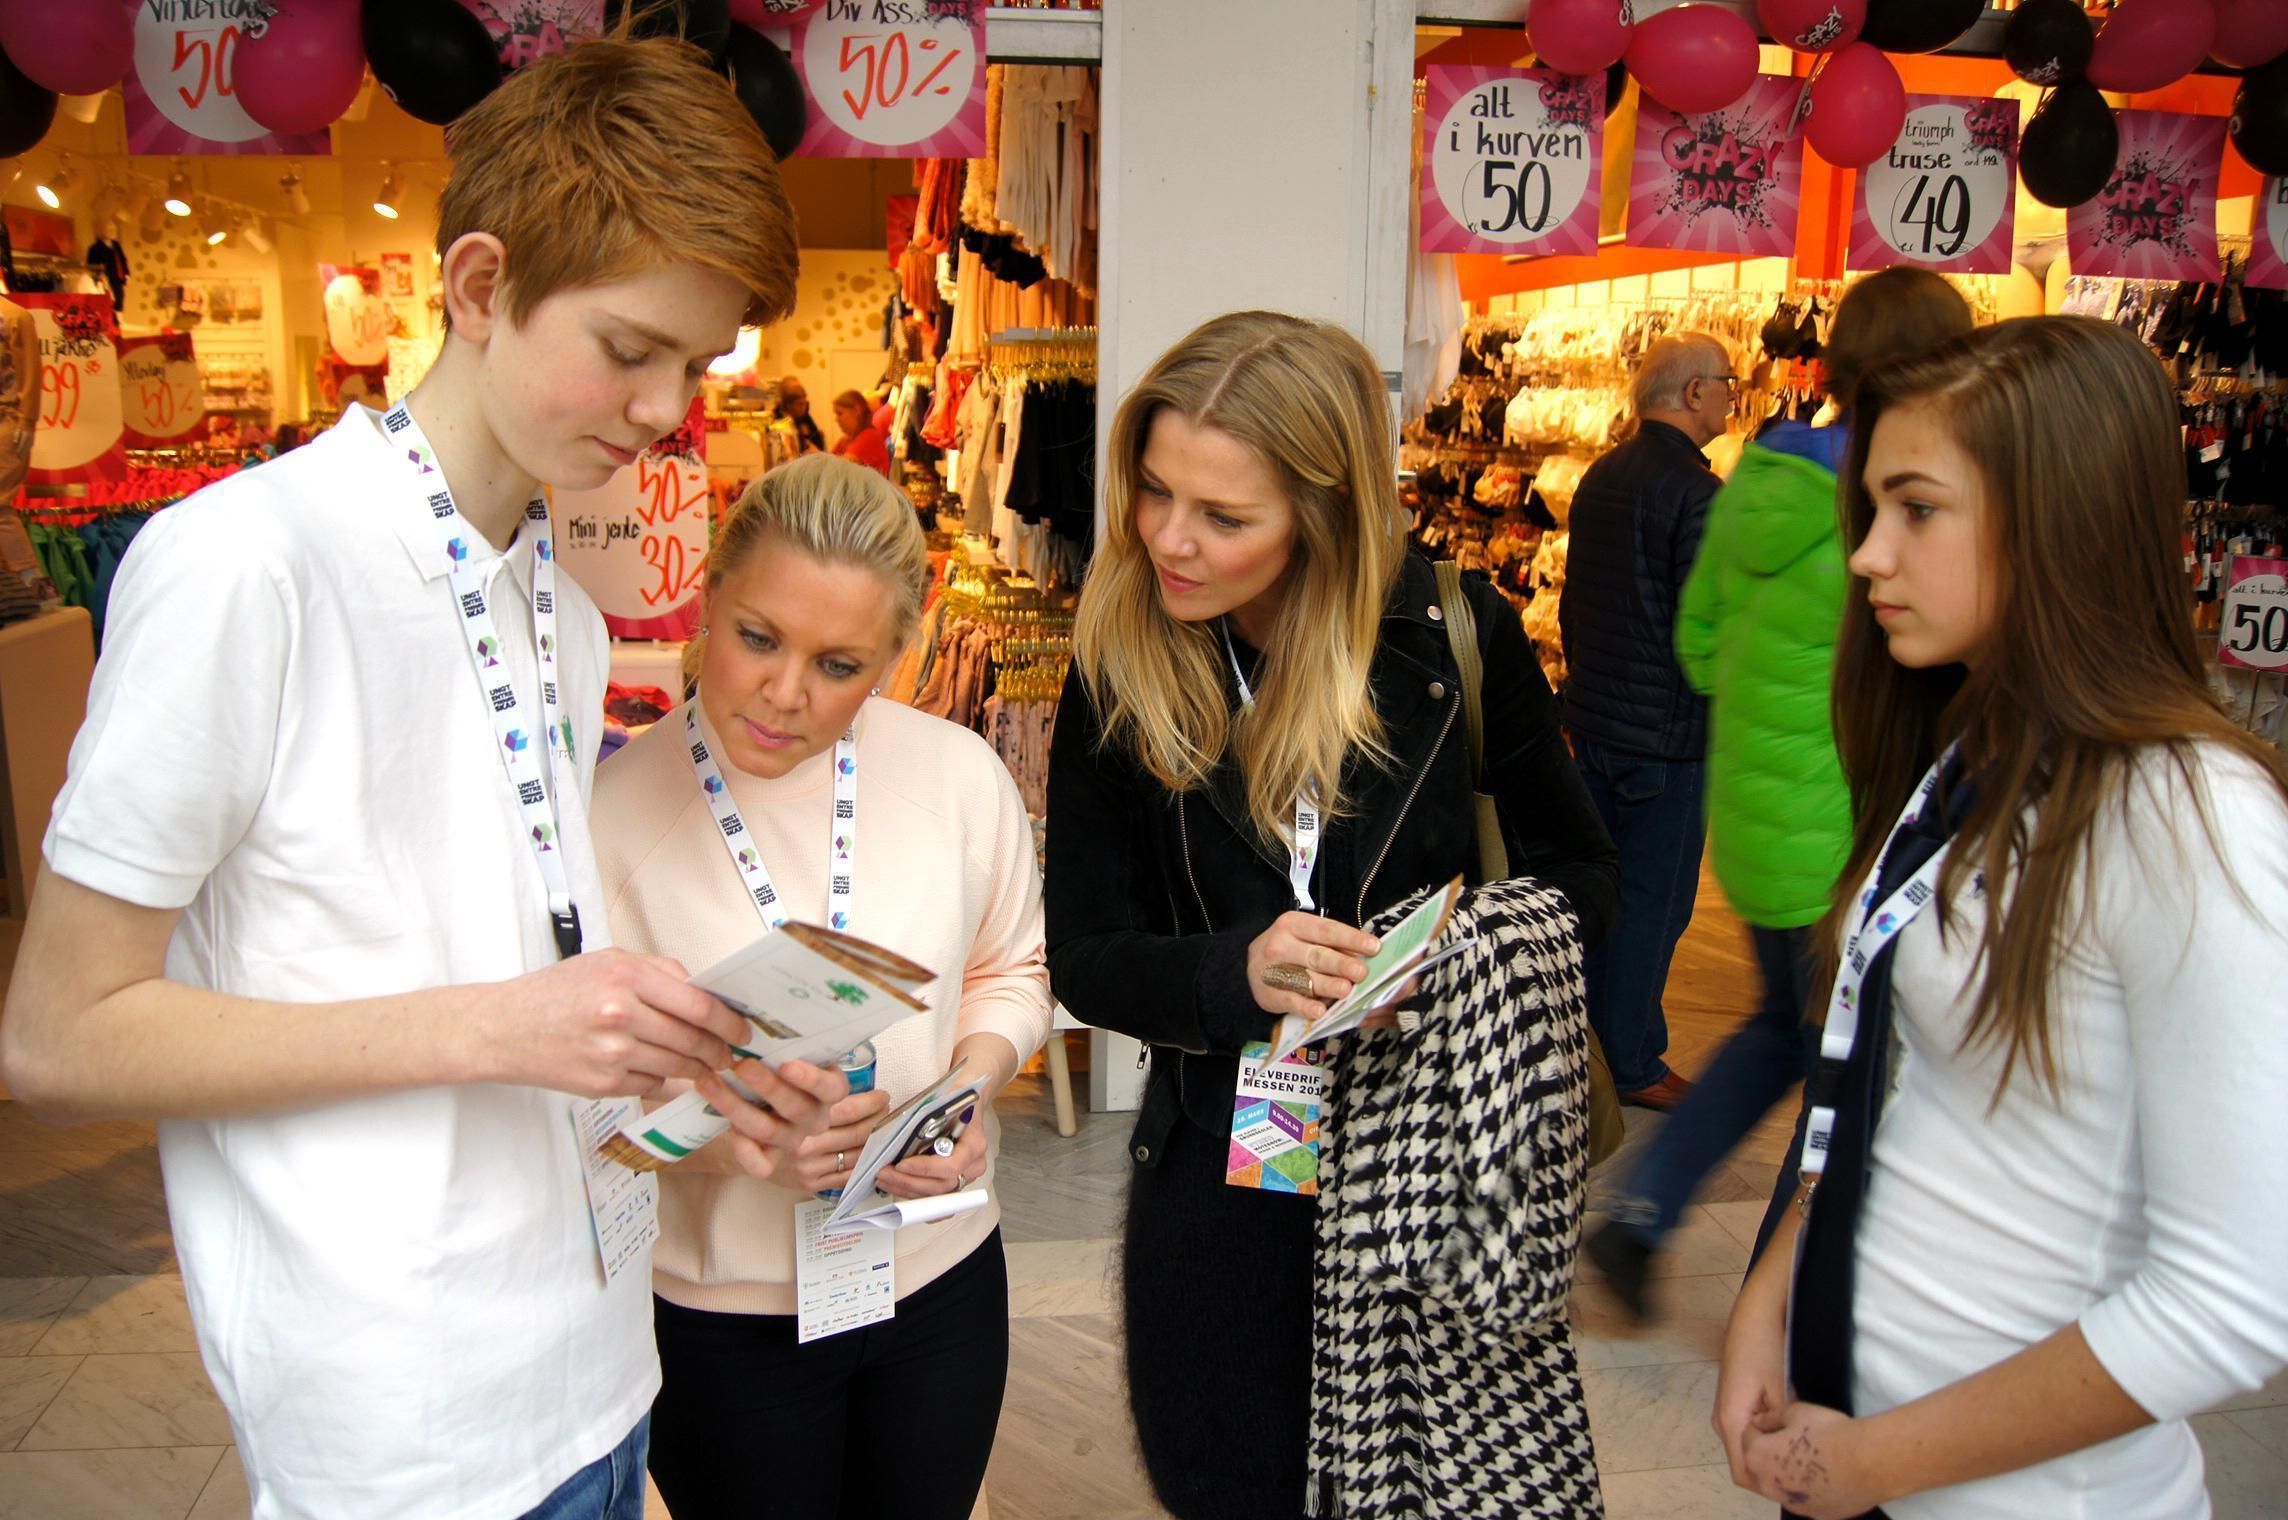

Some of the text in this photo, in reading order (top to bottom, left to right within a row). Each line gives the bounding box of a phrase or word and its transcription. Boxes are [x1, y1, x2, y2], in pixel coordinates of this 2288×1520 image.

[839, 31, 961, 120] 50%
[1470, 85, 1515, 118] alt
[1450, 121, 1582, 160] i kurven
[1905, 115, 1955, 143] triumph
[1661, 126, 1784, 182] CRAZY
[1888, 145, 1952, 170] truse
[1481, 160, 1551, 233] 50
[1682, 179, 1752, 204] DAYS
[1900, 174, 1971, 257] 49
[2112, 215, 2176, 236] DAYS
[635, 461, 707, 526] 50%
[569, 515, 640, 549] Mini jente
[640, 535, 709, 606] 30%
[2230, 603, 2288, 653] 50
[489, 684, 510, 695] UNGT
[518, 779, 539, 789] UNGT
[1243, 1077, 1294, 1092] MESSEN
